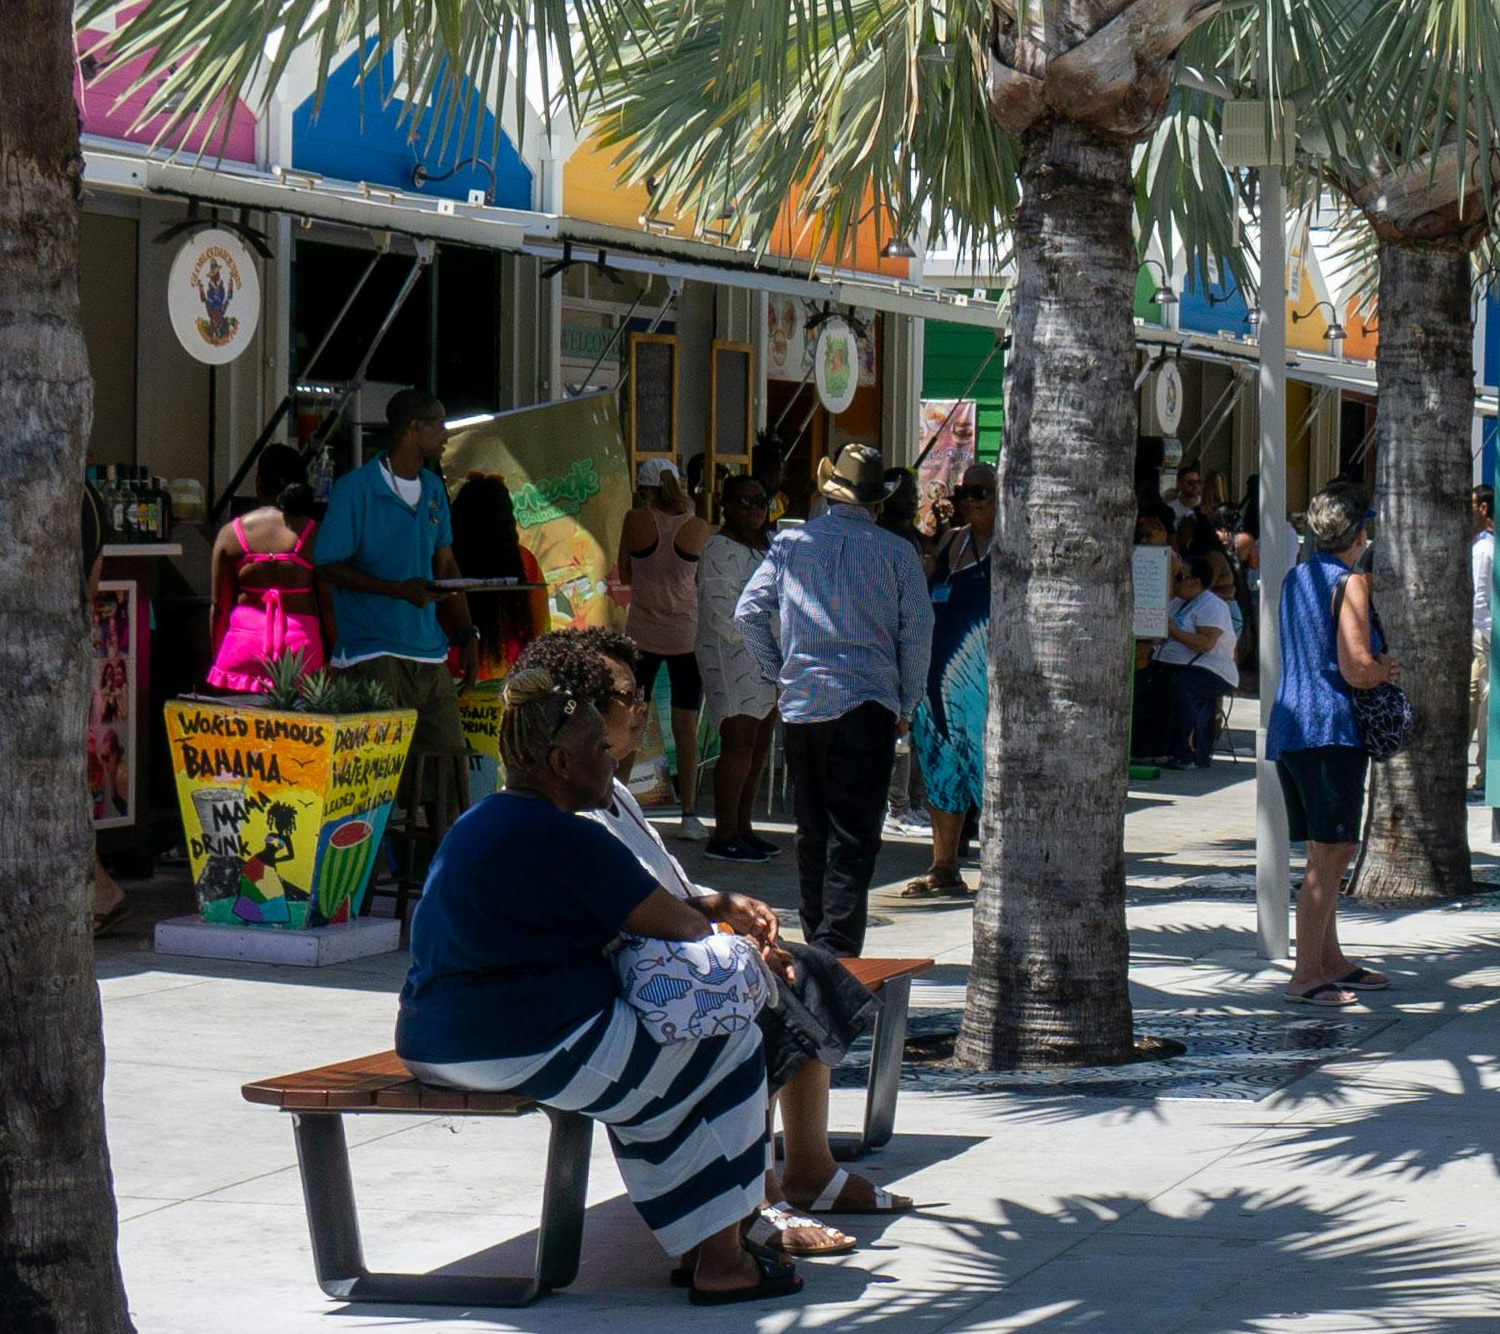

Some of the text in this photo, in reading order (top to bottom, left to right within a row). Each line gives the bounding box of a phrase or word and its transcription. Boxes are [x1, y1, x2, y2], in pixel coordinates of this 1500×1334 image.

[178, 712, 325, 747] WORLD FAMOUS
[333, 723, 370, 755] DRINK
[391, 720, 403, 745] A
[183, 740, 282, 785] BAHAMA
[332, 753, 406, 789] WATERMELON
[211, 790, 272, 833] MAMA
[190, 832, 252, 859] DRINK
